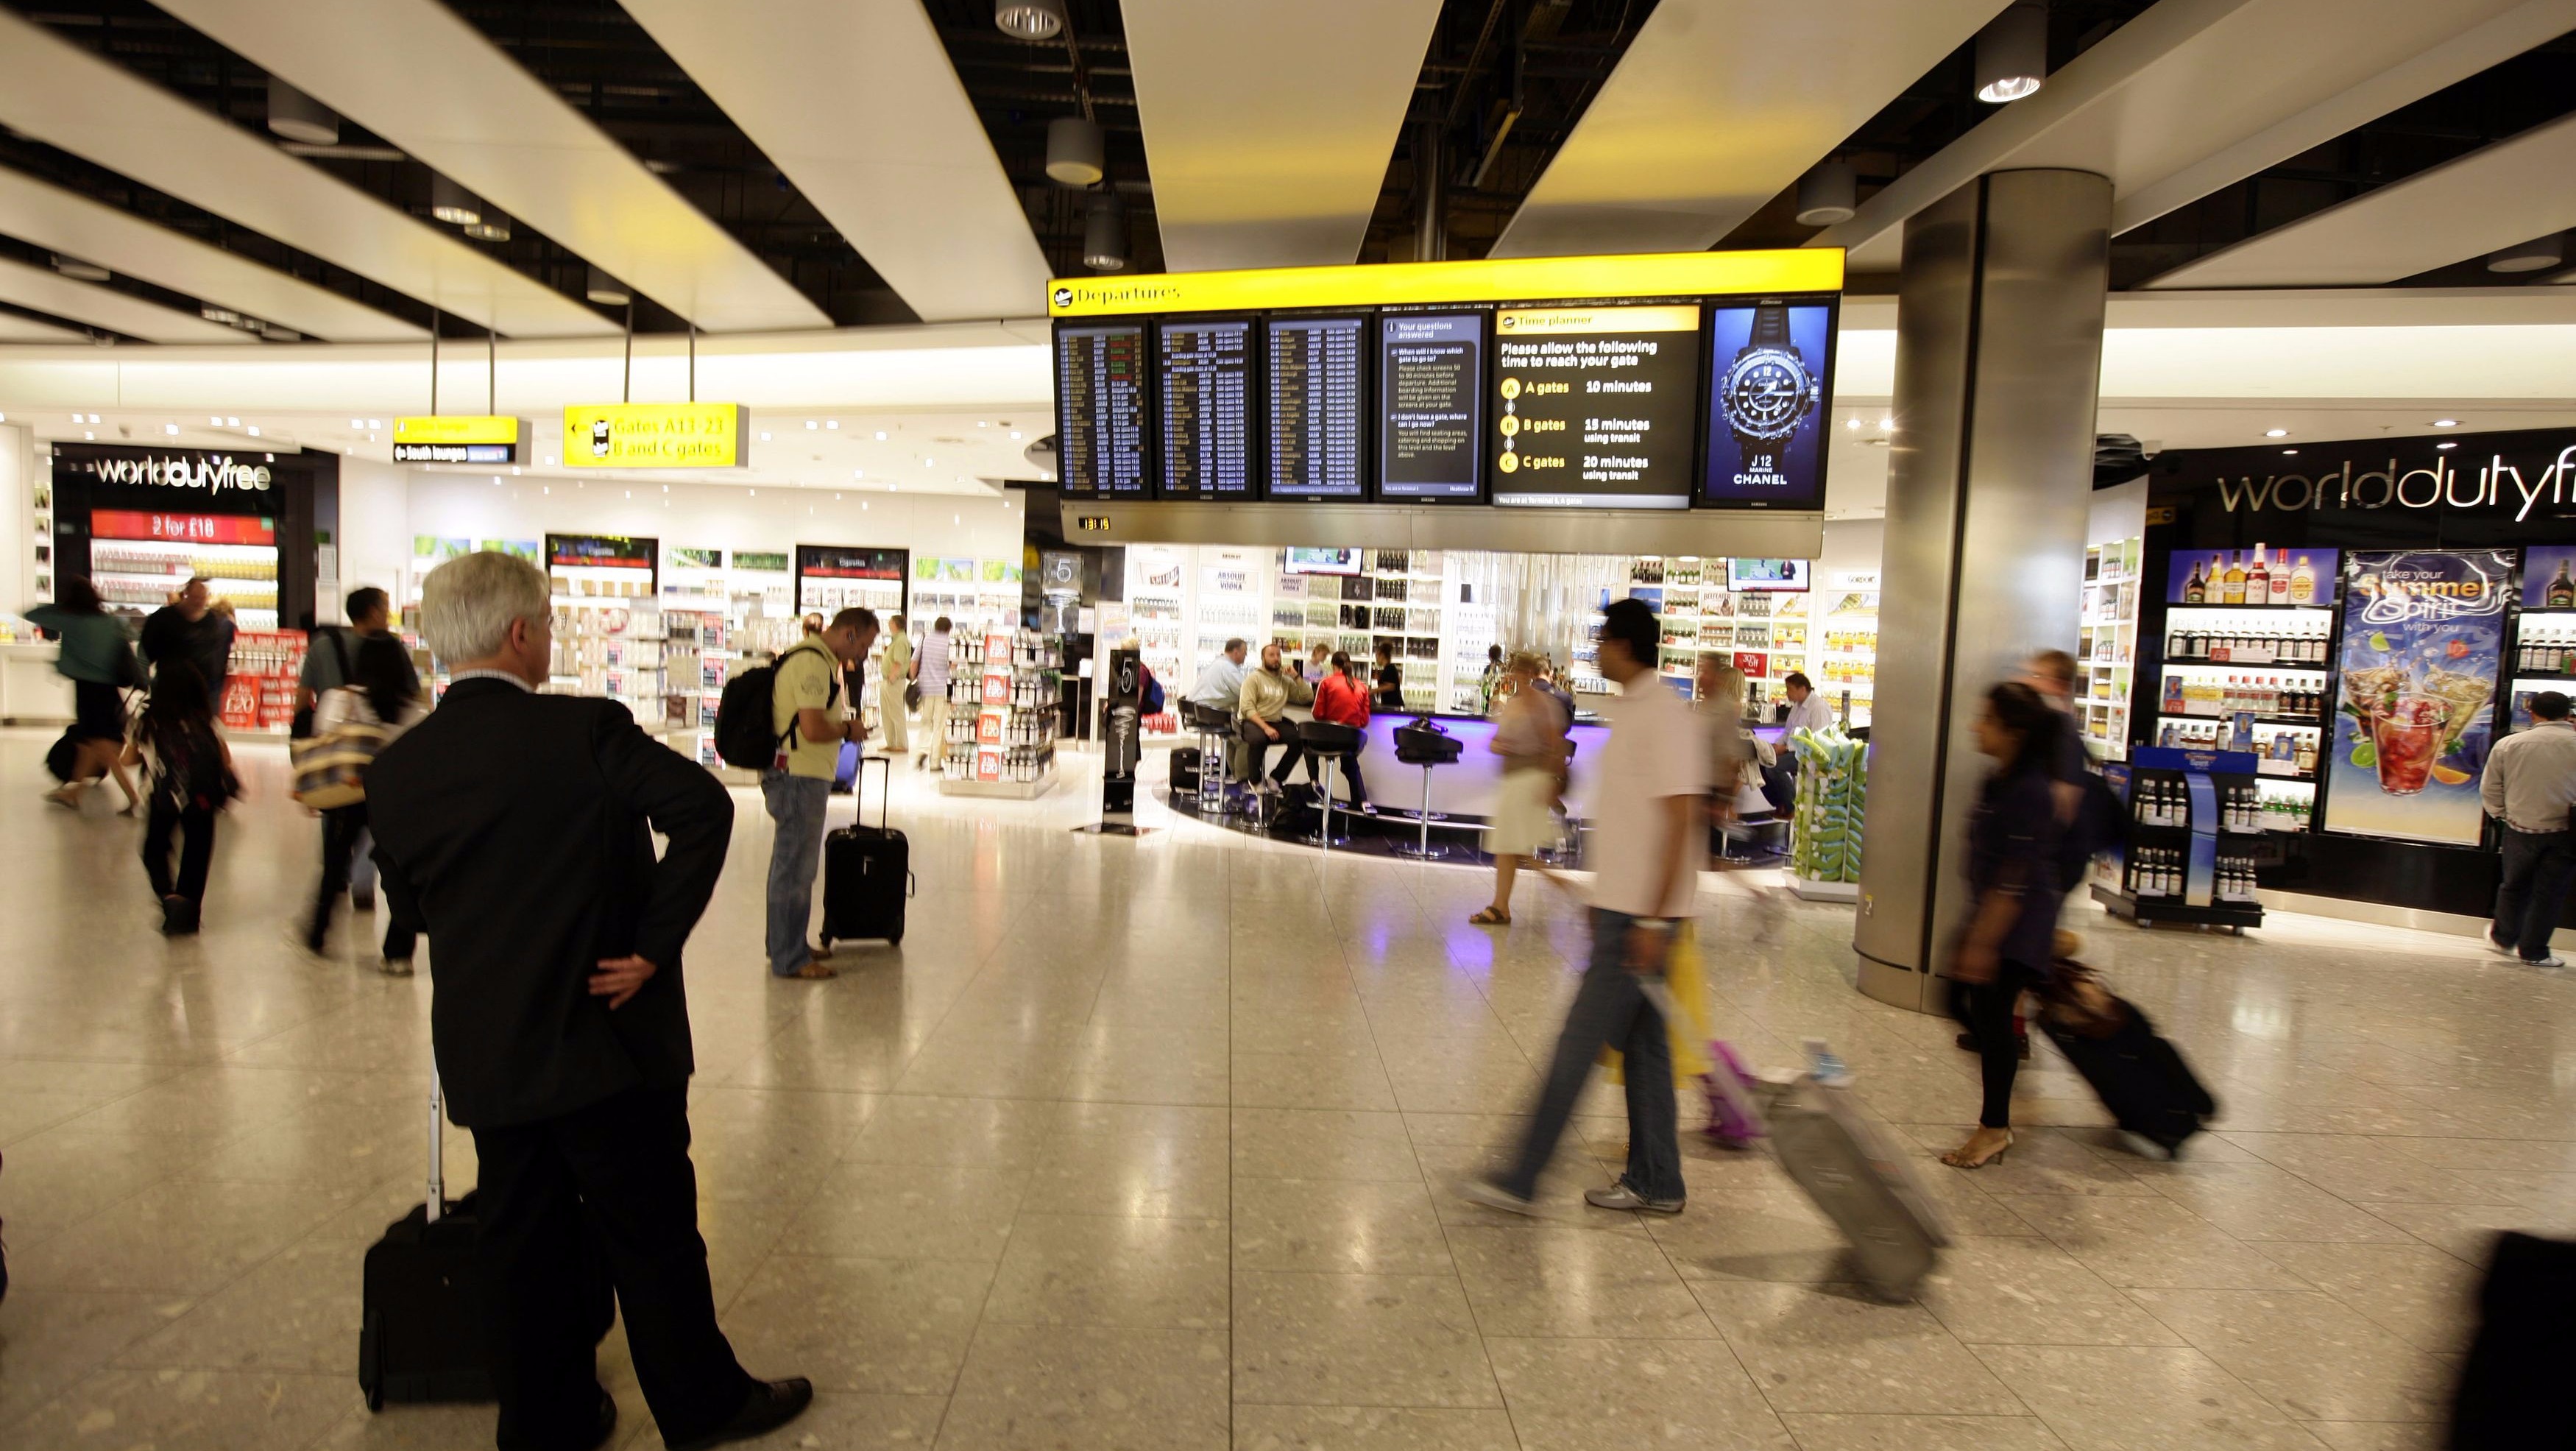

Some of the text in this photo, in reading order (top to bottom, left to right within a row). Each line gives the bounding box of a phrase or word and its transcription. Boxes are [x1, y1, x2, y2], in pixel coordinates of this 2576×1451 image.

[1078, 288, 1180, 305] Departures
[1399, 321, 1452, 331] Your questions
[1519, 316, 1593, 327] Time planner
[1398, 331, 1434, 339] answered
[1501, 340, 1657, 355] Please allow the following
[1501, 355, 1638, 369] time to reach your gate
[1507, 385, 1515, 393] A
[1525, 380, 1652, 395] A gates 10 minutes
[615, 417, 659, 434] Gates
[1524, 418, 1650, 433] B gates 15 minutes
[1584, 432, 1641, 445] using transit
[406, 445, 432, 460] South
[432, 445, 467, 462] lounges
[613, 442, 721, 460] B and C gates
[1523, 455, 1649, 470] C gates 20 minutes
[1752, 454, 1772, 467] J 12
[1582, 470, 1638, 481] using transit
[1733, 474, 1787, 484] CHANEL
[2217, 445, 2576, 522] worlddutyf
[1529, 496, 1554, 504] Terminal
[152, 515, 162, 535] 2
[165, 515, 184, 537] for
[1056, 558, 1072, 582] 5
[1218, 571, 1245, 581] ABSOLUT
[2383, 570, 2444, 581] take your
[1220, 582, 1242, 590] VODKA
[2359, 573, 2494, 597] Summer
[2382, 599, 2460, 619] Spirit
[2402, 623, 2460, 633] with you
[1748, 659, 1759, 667] off
[1122, 657, 1133, 693] 5
